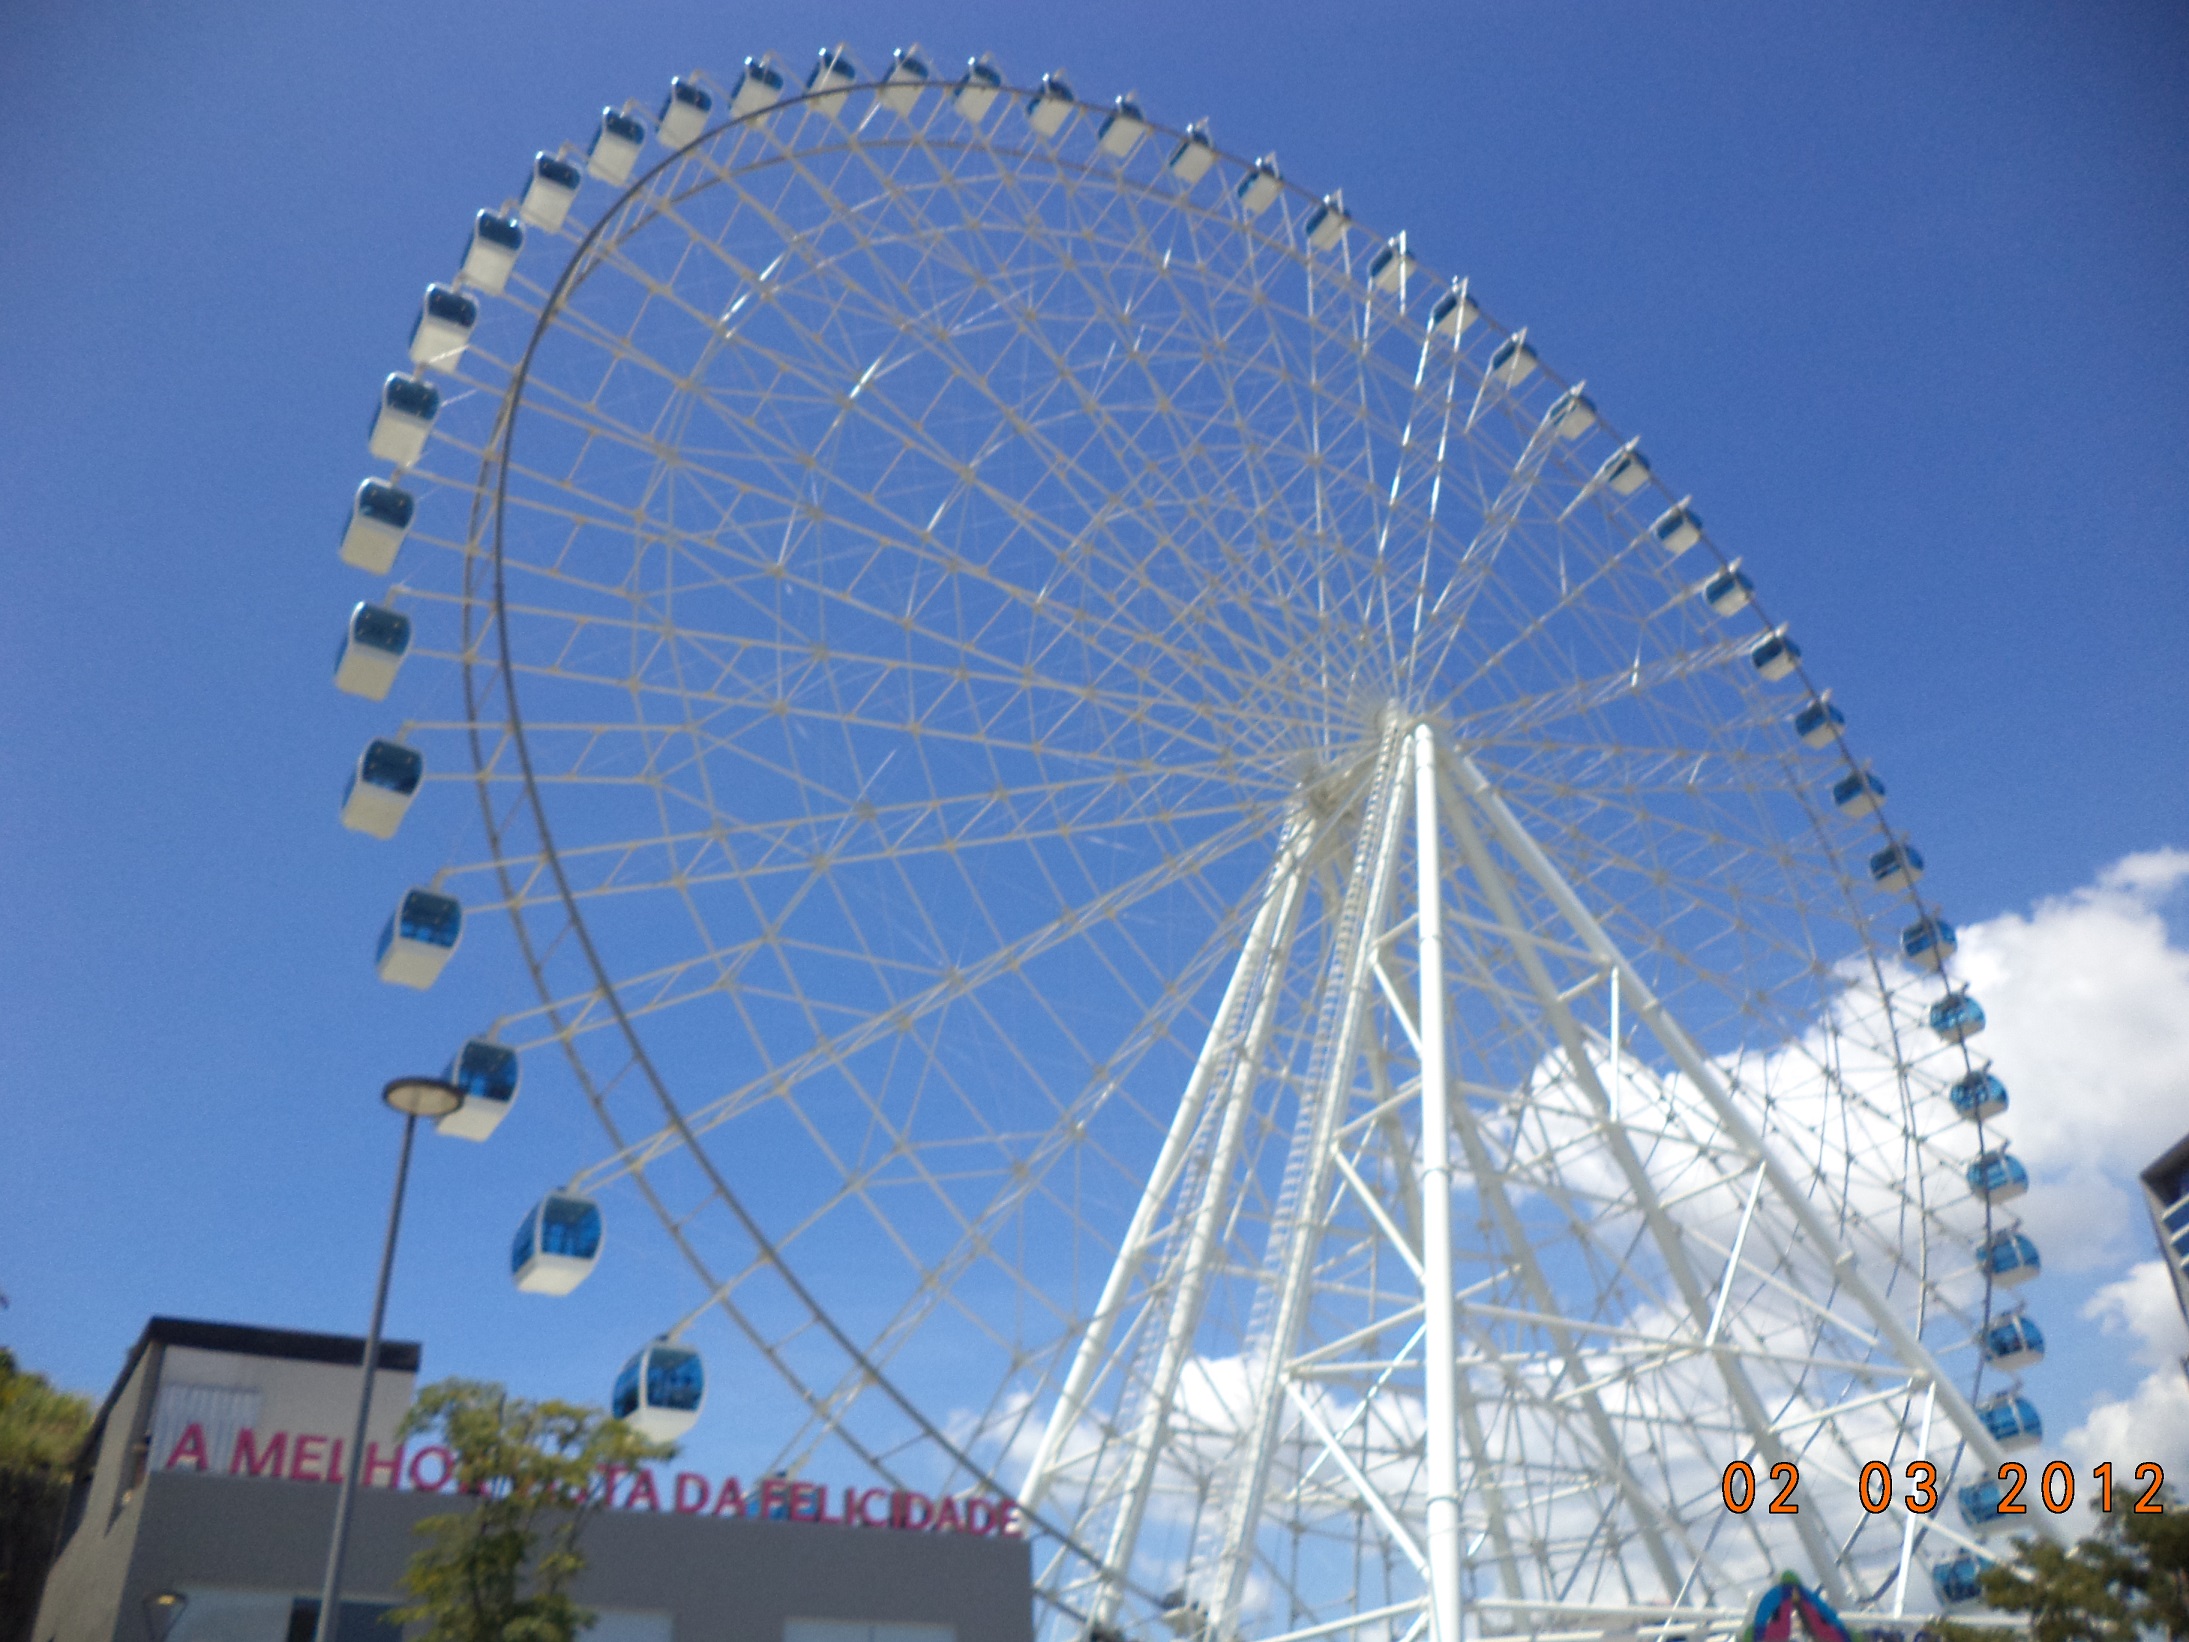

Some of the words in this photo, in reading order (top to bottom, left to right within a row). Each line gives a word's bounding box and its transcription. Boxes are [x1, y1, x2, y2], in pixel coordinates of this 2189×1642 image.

[165, 1422, 209, 1471] A
[229, 1427, 490, 1497] MELHO
[674, 1471, 747, 1518] DA
[757, 1476, 1025, 1538] FELICIDADE
